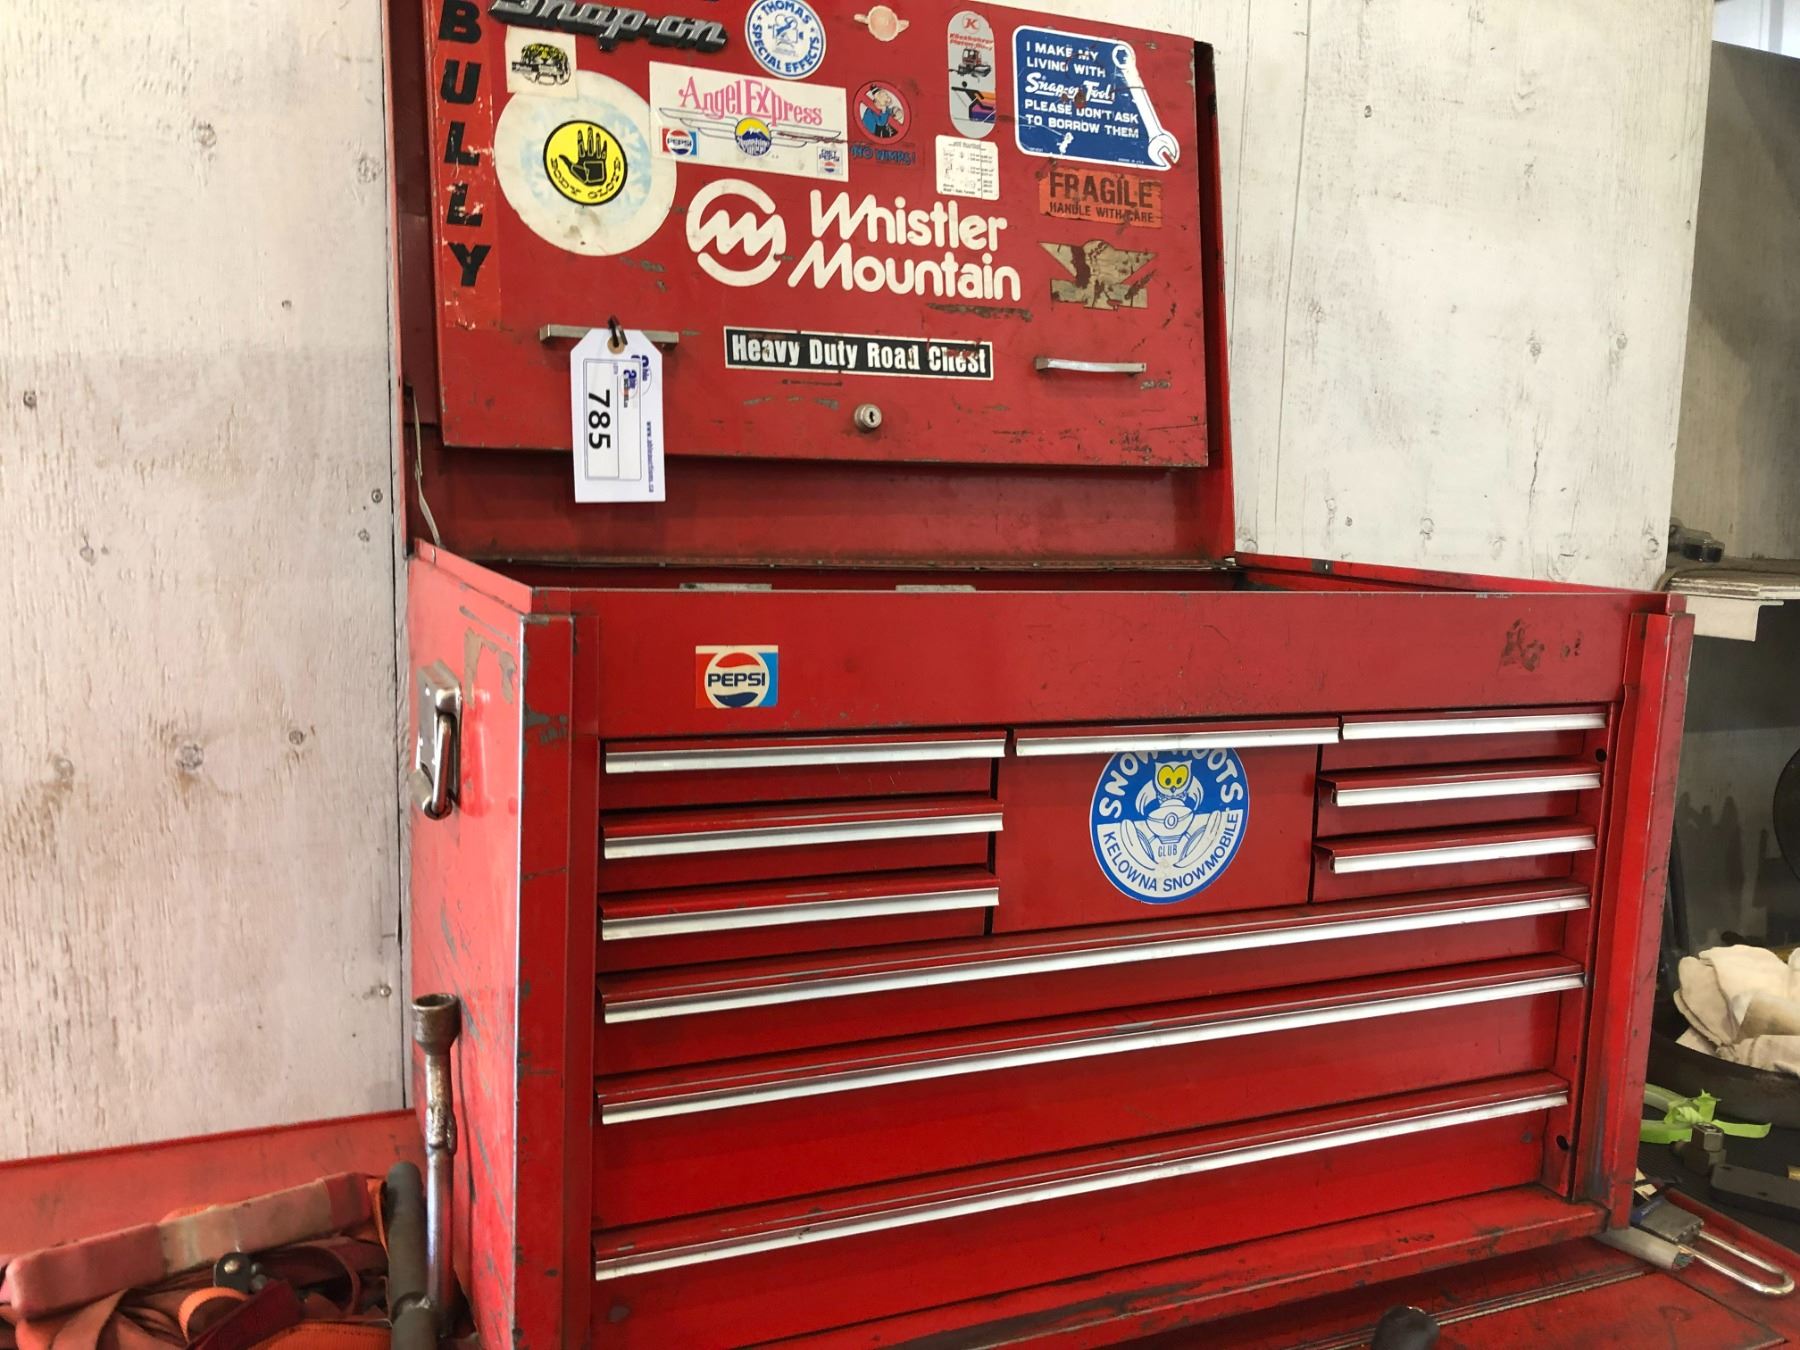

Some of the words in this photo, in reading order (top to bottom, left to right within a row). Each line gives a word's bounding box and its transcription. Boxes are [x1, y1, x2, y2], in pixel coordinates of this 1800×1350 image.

[761, 0, 812, 24] THOMAS
[752, 23, 781, 70] SPECIAL
[785, 36, 820, 73] EFFECTS
[1026, 41, 1031, 52] I
[1034, 43, 1073, 58] MAKE
[1078, 49, 1099, 61] MY
[1026, 57, 1069, 73] LIVING
[1073, 64, 1106, 78] WITH
[678, 76, 742, 121] Angel
[1024, 98, 1073, 116] PLEASE
[1076, 106, 1113, 121] DON'T
[1114, 110, 1139, 125] ASK
[438, 0, 492, 287] BULLY
[1025, 114, 1043, 127] TO
[1048, 116, 1100, 134] BORROW
[1104, 124, 1139, 139] THEM
[550, 157, 582, 197] BODY
[587, 156, 622, 200] GLOVE
[1049, 171, 1154, 209] FRAGILE
[810, 189, 1008, 252] Whistler
[1049, 201, 1091, 217] HANDLE
[1096, 206, 1121, 220] WITH
[1125, 209, 1154, 223] CARE
[787, 239, 1021, 302] Mountain
[732, 333, 800, 366] Heavy
[809, 338, 858, 369] Duty
[867, 342, 921, 371] Road
[928, 345, 987, 374] Chest
[587, 388, 612, 450] 785
[707, 672, 766, 688] PEPSI
[1098, 750, 1159, 819] SNOW
[1102, 830, 1158, 892] KELOWNA
[1162, 812, 1239, 893] SNOWMOBILE
[1157, 844, 1178, 858] CLUB
